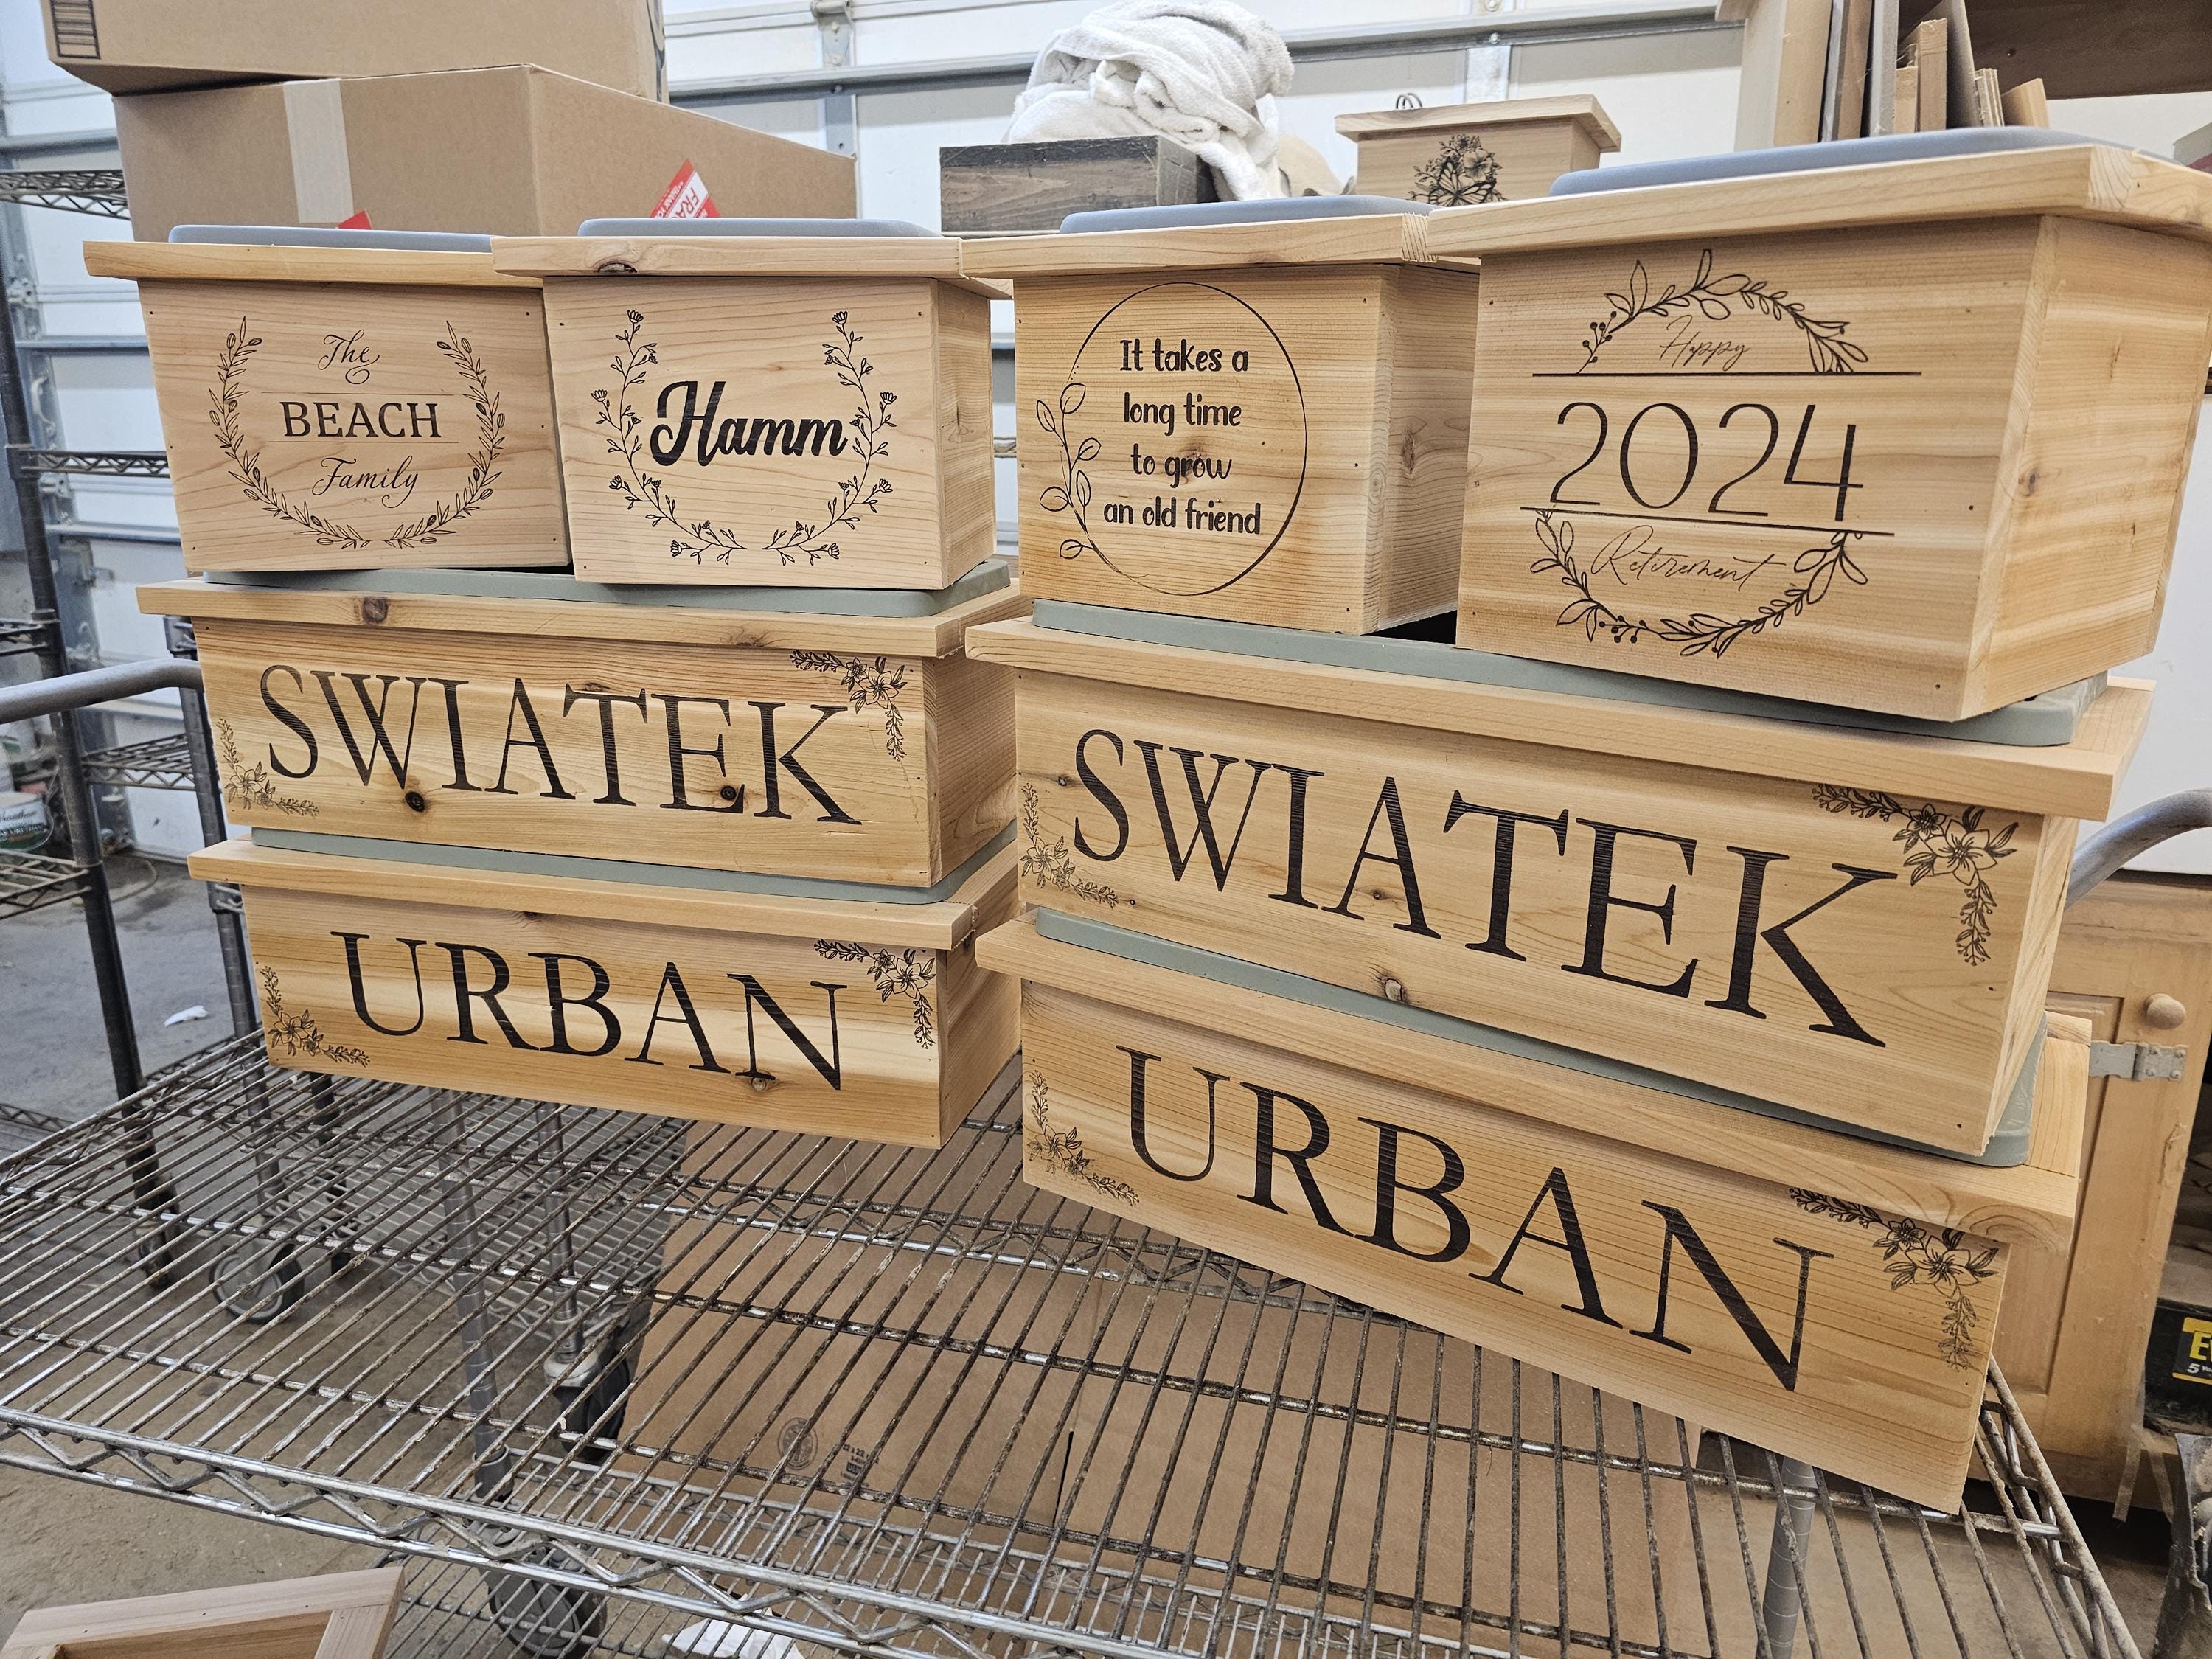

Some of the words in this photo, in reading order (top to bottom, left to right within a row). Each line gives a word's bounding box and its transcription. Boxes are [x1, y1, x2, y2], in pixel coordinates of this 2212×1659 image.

[672, 187, 700, 218] FRA
[317, 329, 380, 385] The
[1119, 338, 1144, 372] It
[1152, 338, 1223, 372] takes
[1231, 349, 1249, 372] a
[1659, 314, 1750, 372] Happy
[279, 401, 442, 438] BEACH
[650, 380, 848, 467] Hamm
[1124, 392, 1175, 437] long
[1183, 392, 1242, 427] time
[311, 455, 419, 509] Family
[1130, 442, 1155, 476] to
[1164, 455, 1232, 489] grow
[1549, 402, 1864, 522] 2024
[1103, 503, 1134, 524] an
[1142, 495, 1177, 528] old
[1185, 497, 1262, 535] friend
[1590, 524, 1787, 591] Retirement
[260, 663, 862, 826] SWIATEK
[1074, 728, 1897, 1048] SWIATEK
[330, 931, 848, 1091] URBAN
[1116, 1045, 1834, 1392] URBAN
